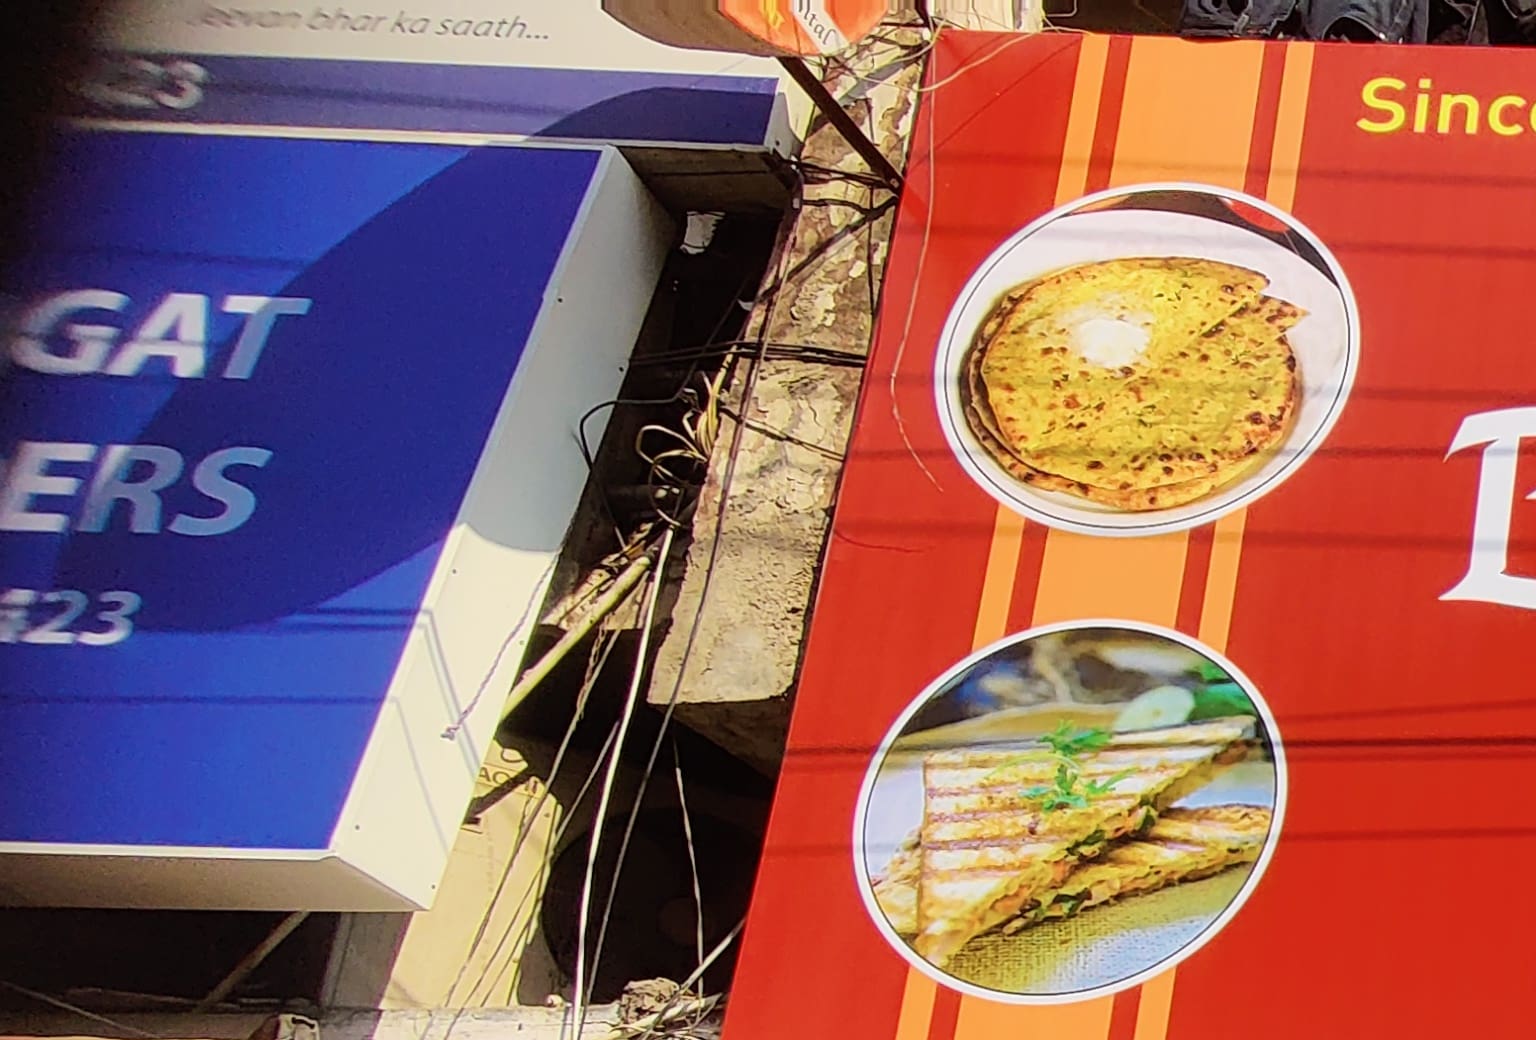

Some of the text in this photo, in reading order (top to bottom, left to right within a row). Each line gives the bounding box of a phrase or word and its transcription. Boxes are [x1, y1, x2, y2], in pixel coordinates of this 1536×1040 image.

[306, 6, 386, 33] bhar
[389, 11, 428, 35] ka
[8, 288, 312, 380] GAT
[0, 441, 274, 536] ERS
